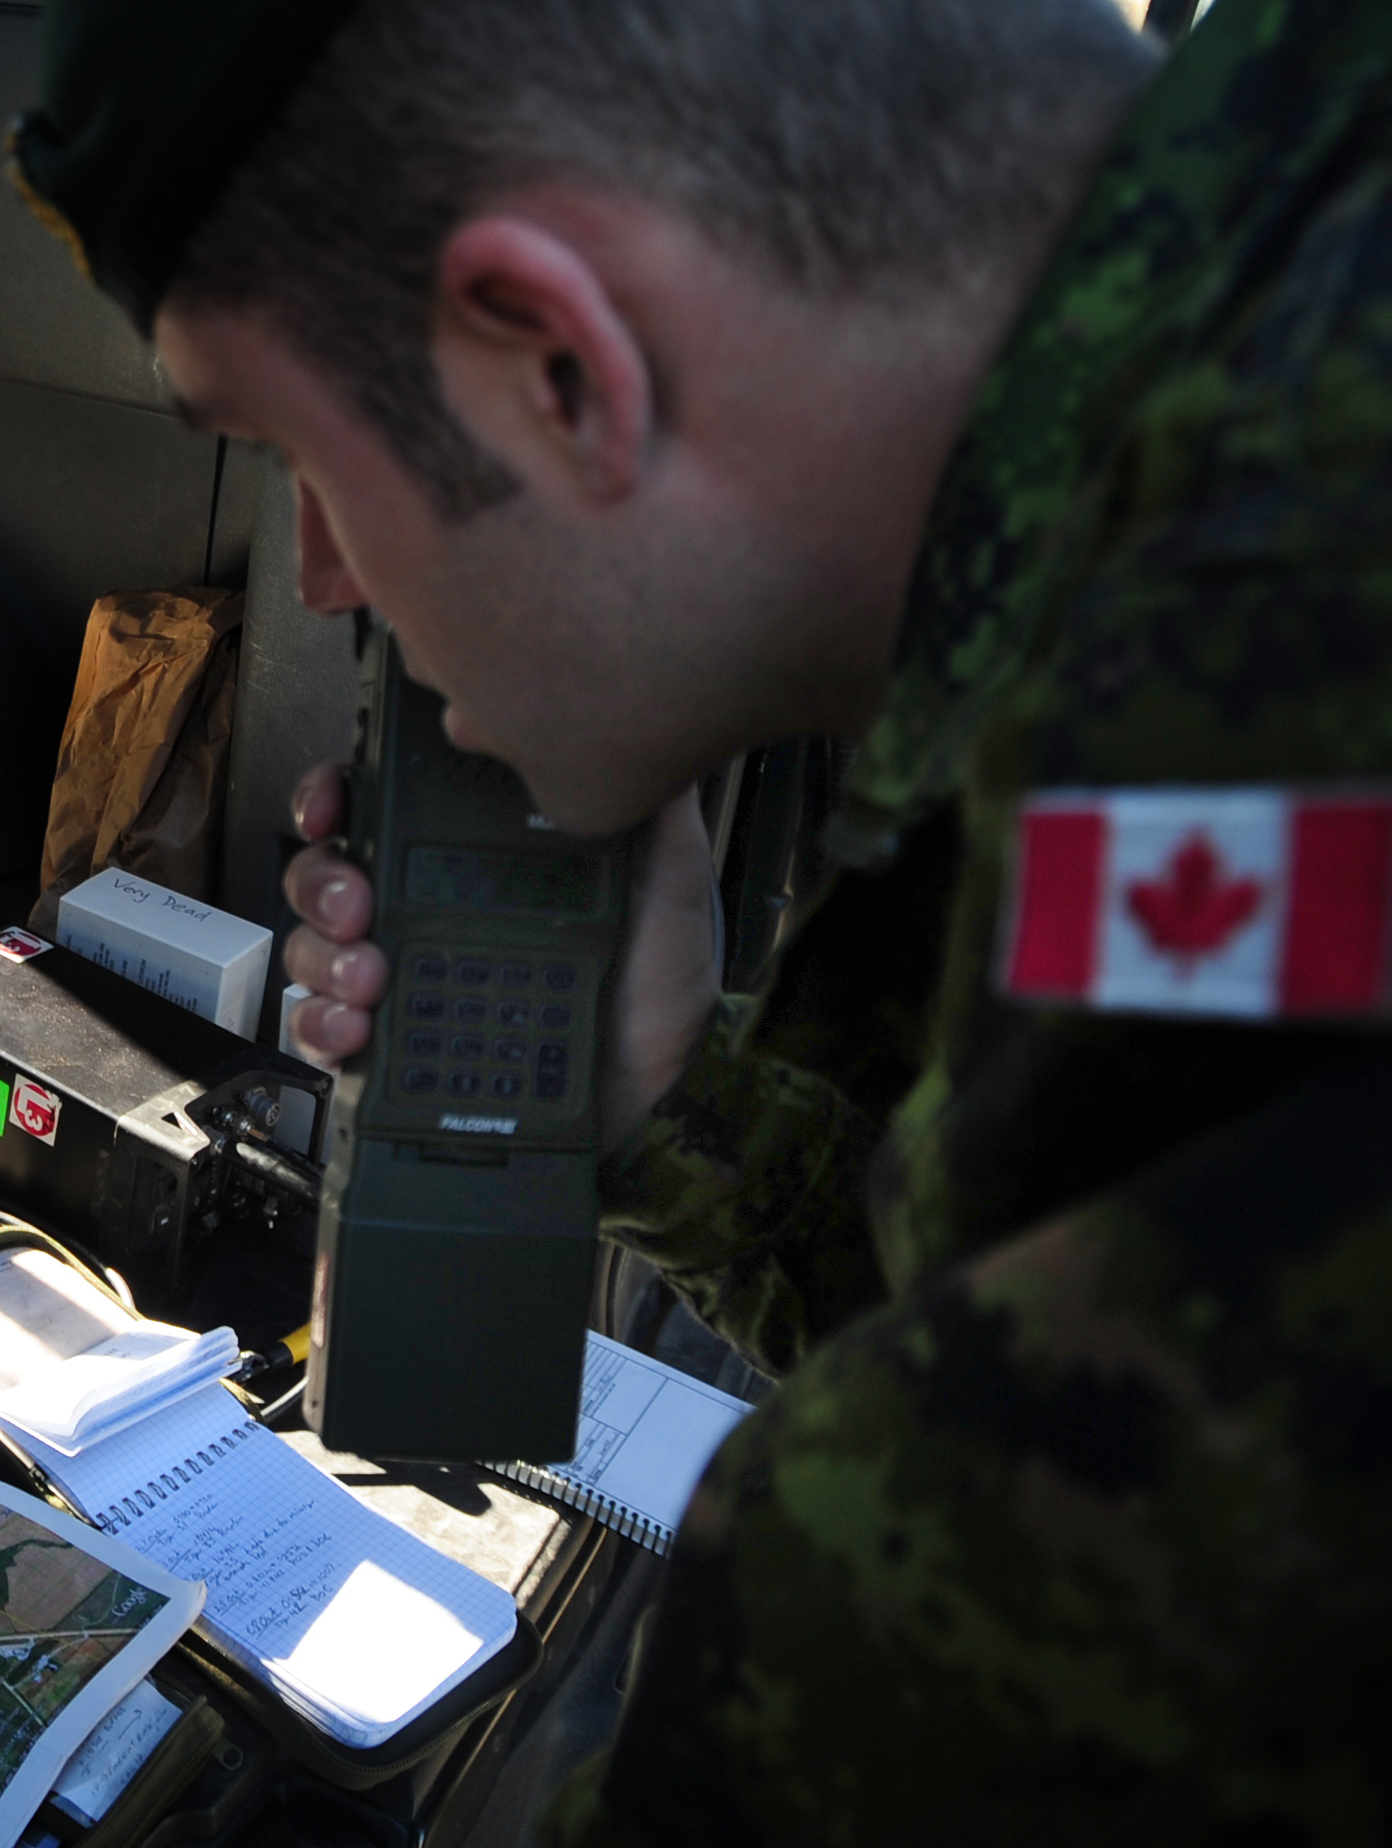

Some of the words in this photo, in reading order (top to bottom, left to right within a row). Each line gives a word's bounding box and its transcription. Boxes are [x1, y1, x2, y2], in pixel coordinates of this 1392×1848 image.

[113, 878, 151, 904] Very
[161, 895, 212, 922] Dead
[111, 1586, 149, 1618] Google
